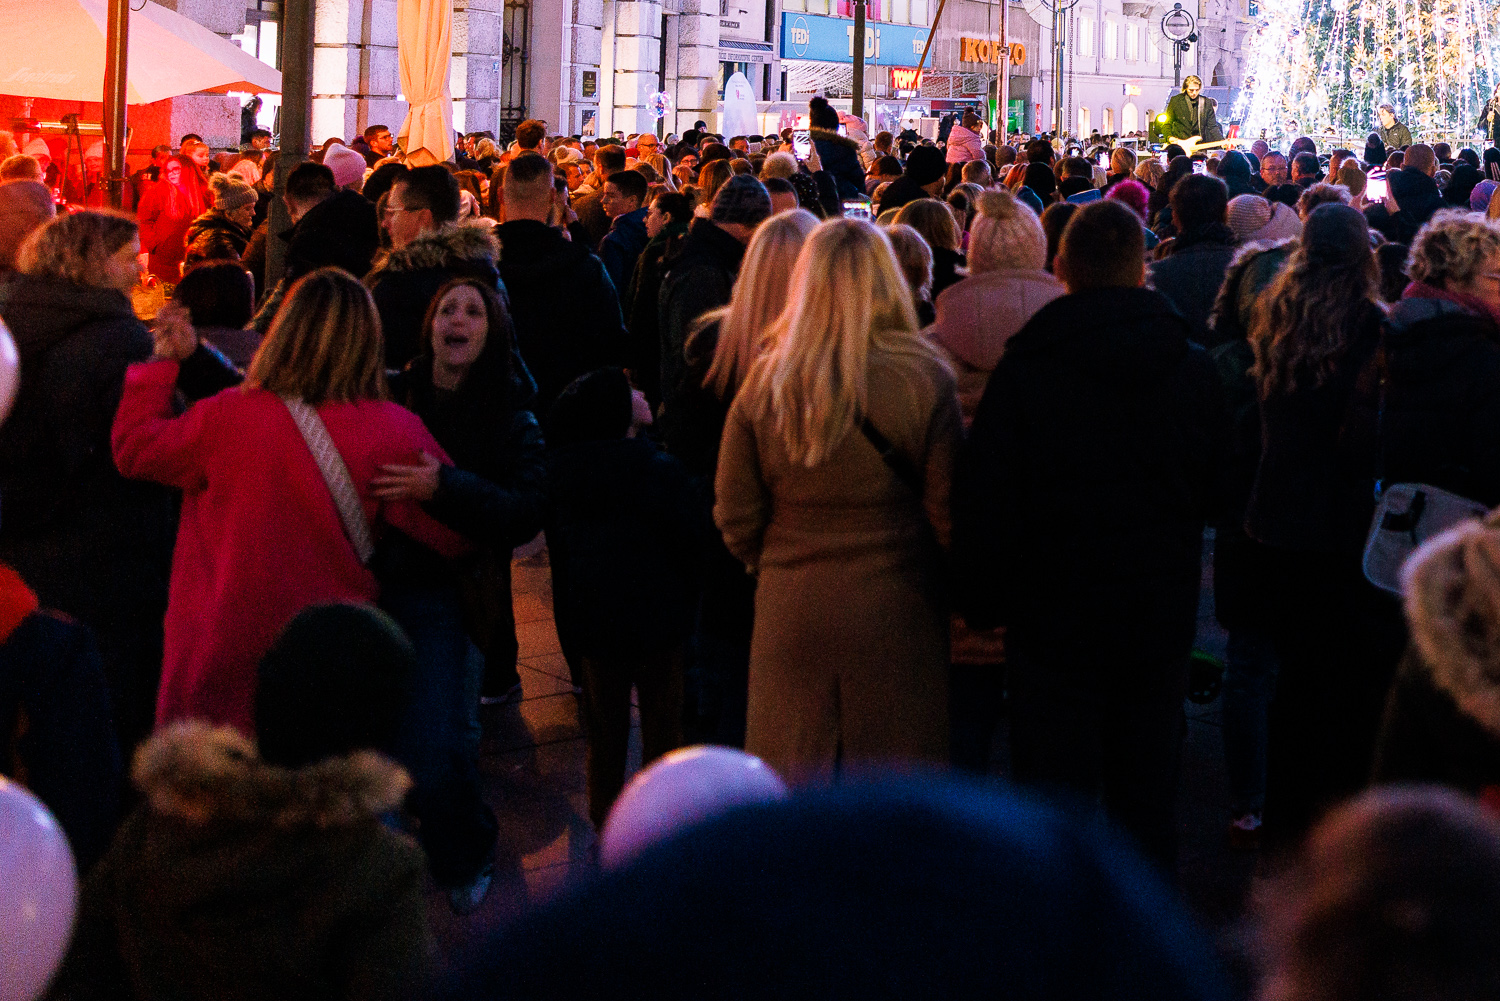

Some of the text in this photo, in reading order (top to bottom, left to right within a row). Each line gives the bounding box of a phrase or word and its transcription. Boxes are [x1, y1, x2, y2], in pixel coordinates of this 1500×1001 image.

[791, 27, 810, 45] TEDi
[847, 26, 881, 59] TDi
[912, 39, 926, 55] TED
